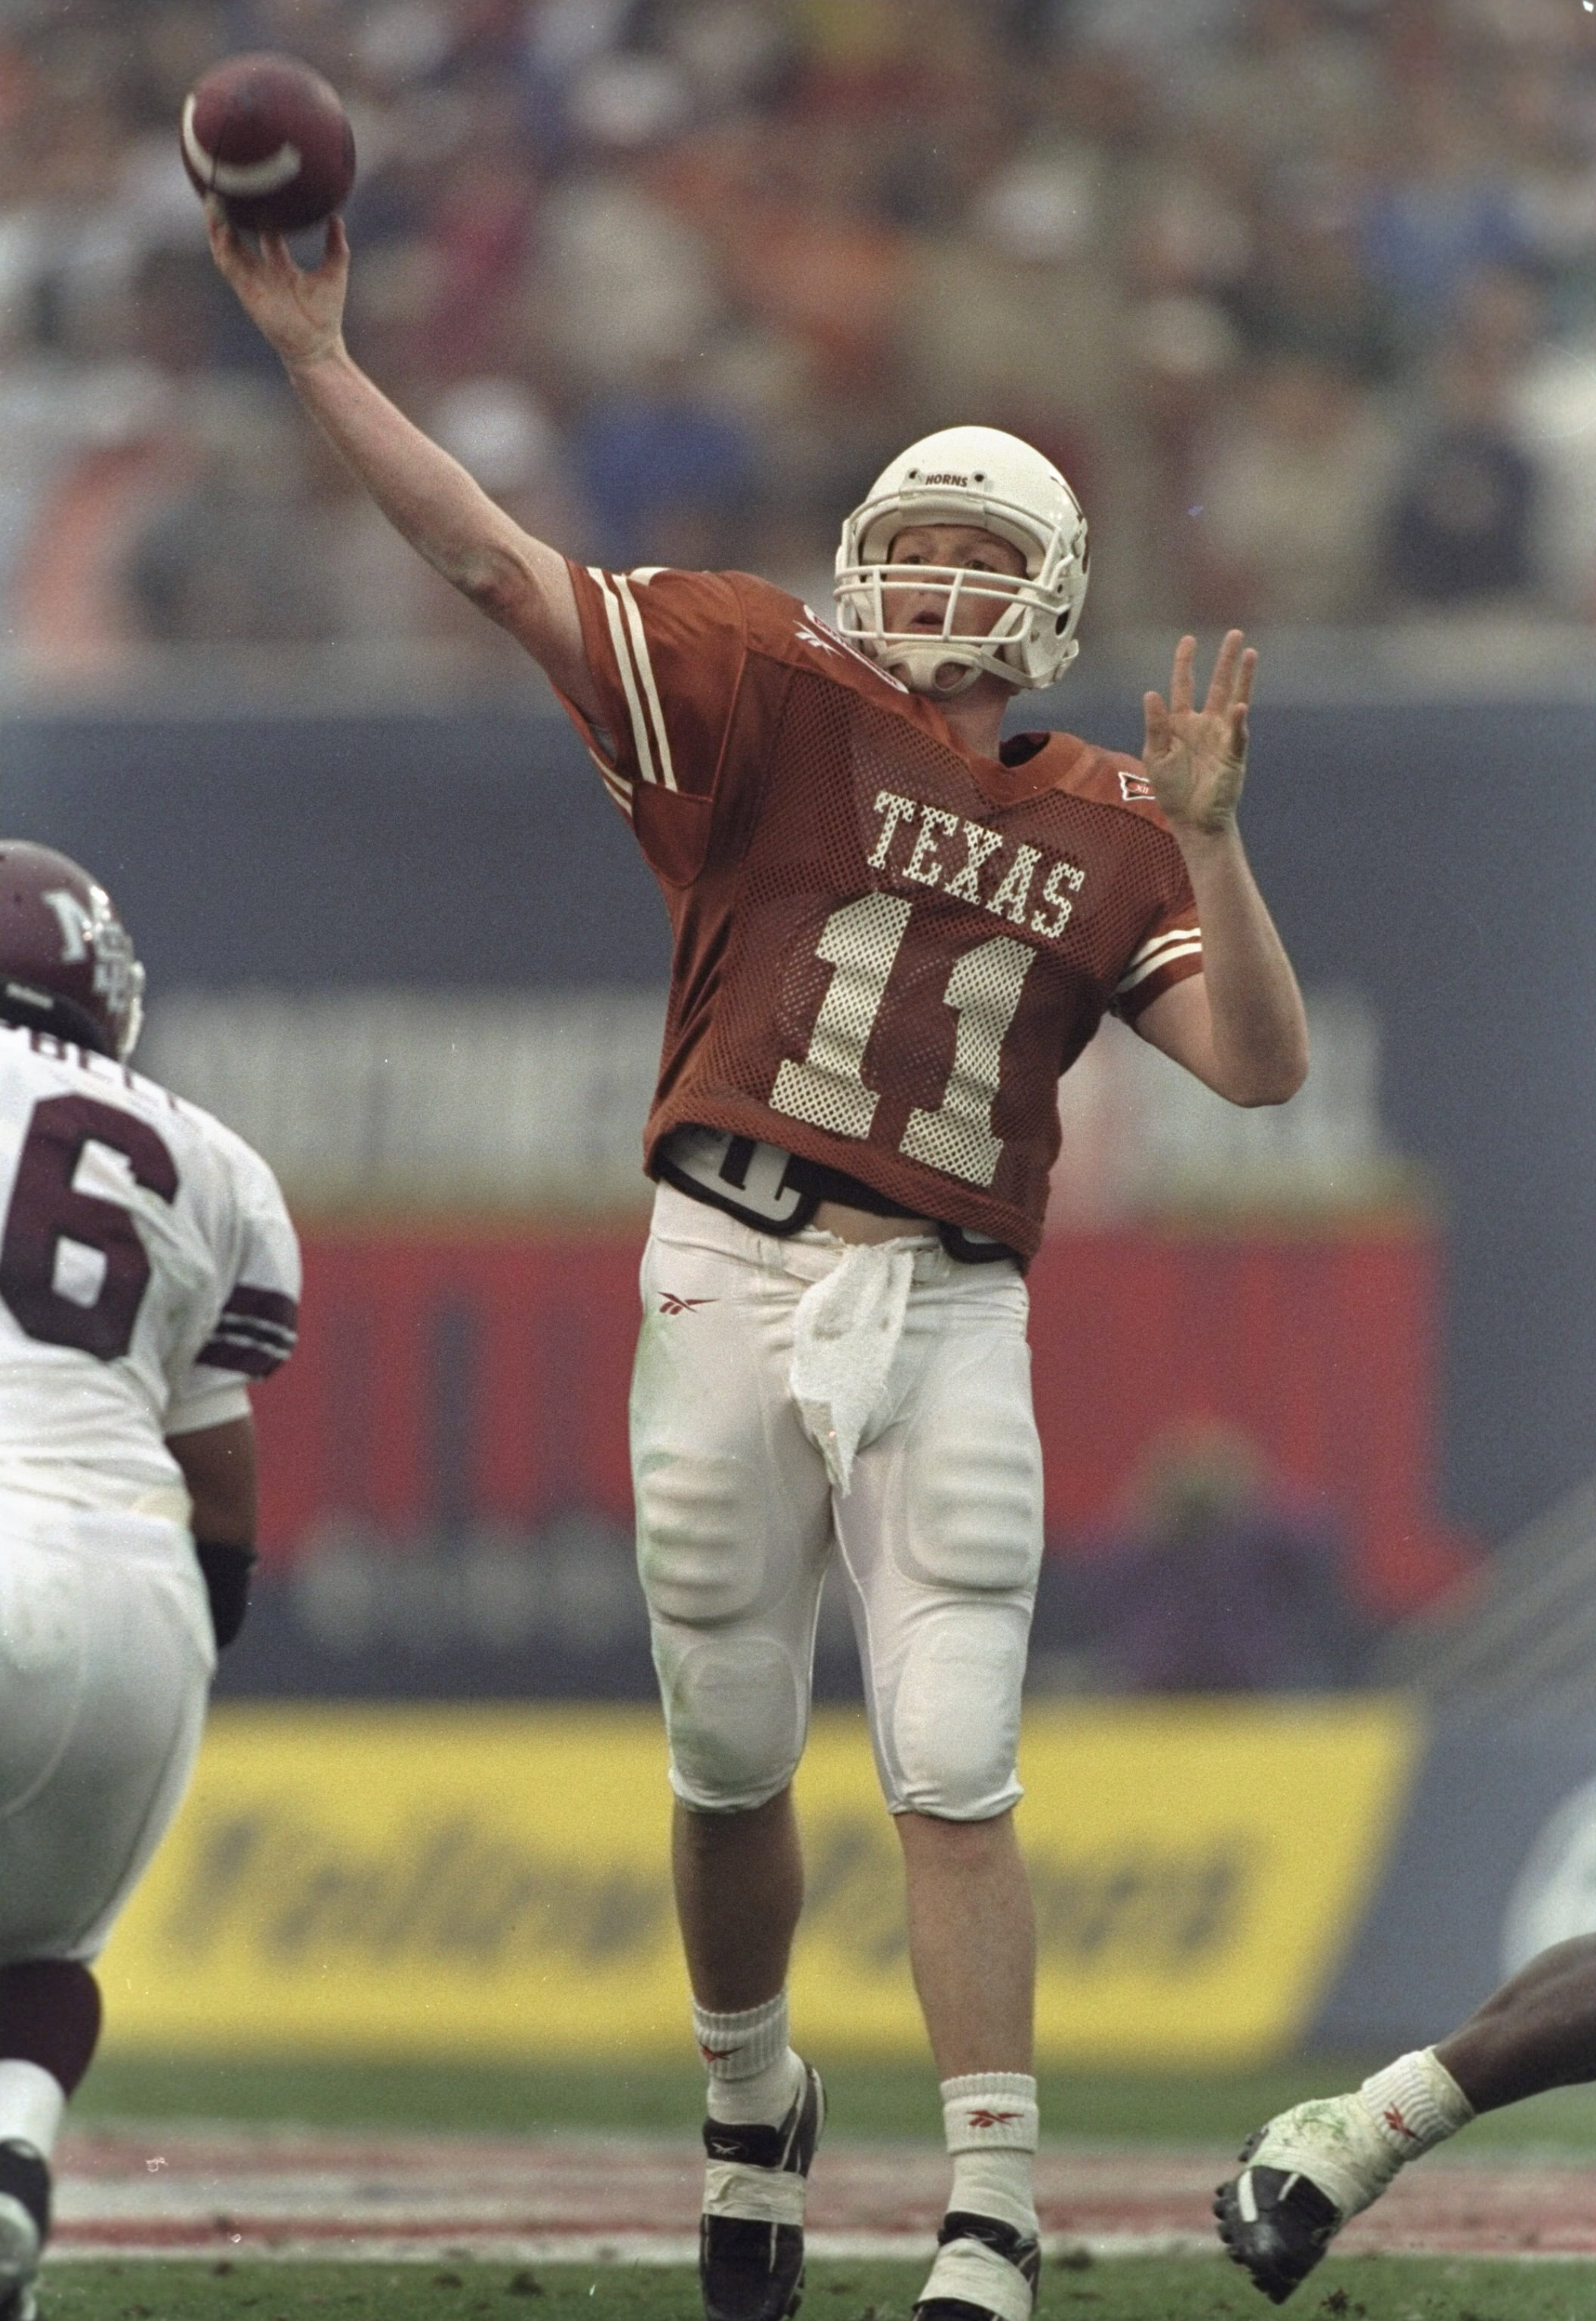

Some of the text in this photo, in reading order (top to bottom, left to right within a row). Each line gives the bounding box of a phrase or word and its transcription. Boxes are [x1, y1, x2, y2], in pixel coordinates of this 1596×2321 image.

[925, 474, 968, 487] HORNS
[868, 790, 1085, 938] TEXAS
[769, 891, 1037, 1188] 11
[0, 1091, 180, 1361] 6
